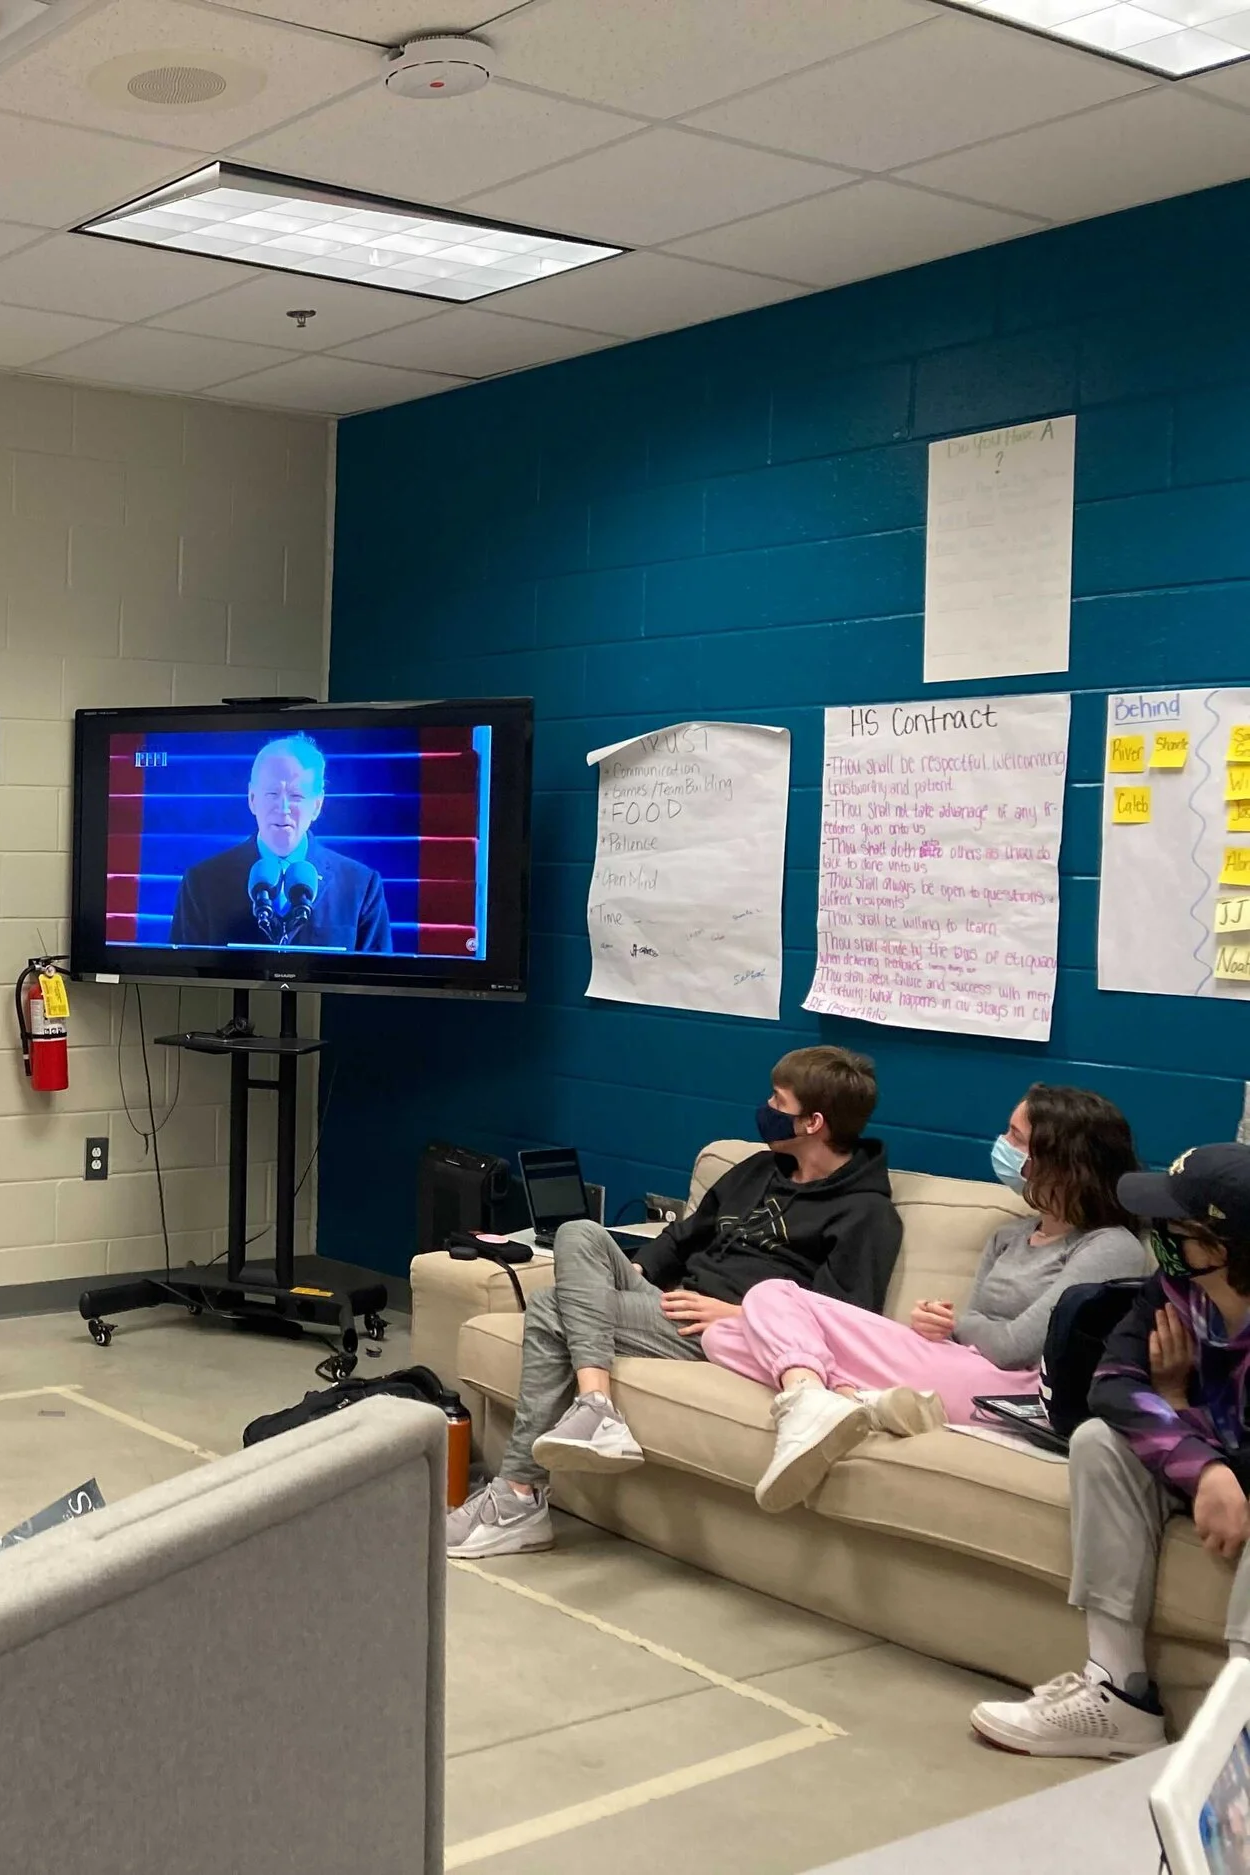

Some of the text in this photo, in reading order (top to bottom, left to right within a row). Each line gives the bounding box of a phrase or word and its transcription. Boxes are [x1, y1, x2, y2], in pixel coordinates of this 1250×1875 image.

[1040, 421, 1054, 441] A
[1115, 693, 1180, 721] Behind
[850, 704, 999, 737] HS Contract
[639, 727, 713, 755] TRUST
[1112, 738, 1144, 761] River
[613, 762, 700, 779] Communication
[611, 798, 683, 825] FOOD
[1117, 793, 1149, 814] Caleb
